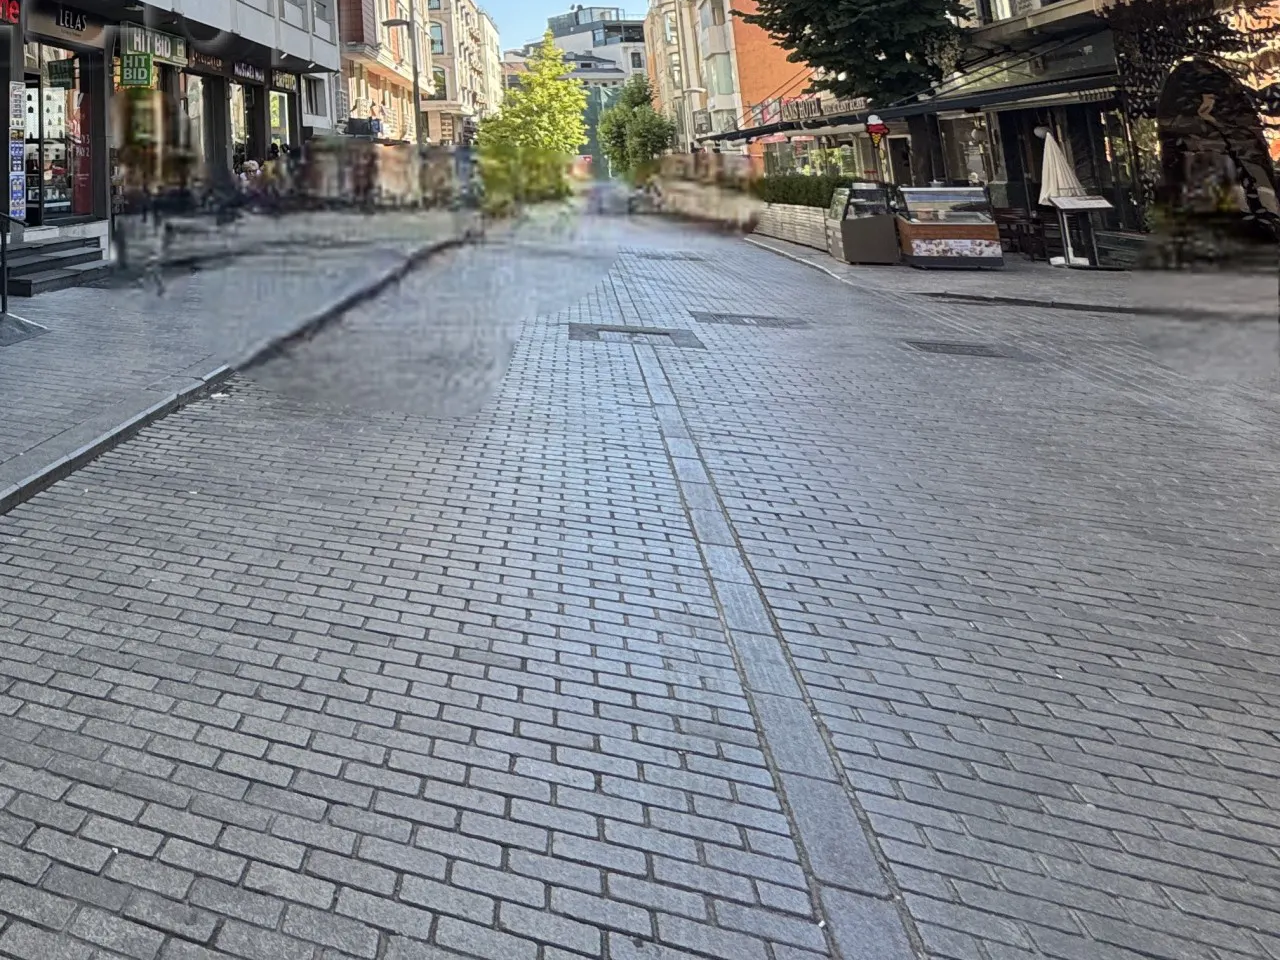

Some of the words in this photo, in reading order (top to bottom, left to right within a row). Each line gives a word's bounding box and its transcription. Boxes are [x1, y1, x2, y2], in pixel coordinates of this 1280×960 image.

[59, 8, 87, 32] LELAS
[133, 27, 152, 54] HIT
[154, 32, 171, 59] BID
[123, 55, 148, 68] HIT
[123, 67, 148, 80] BID
